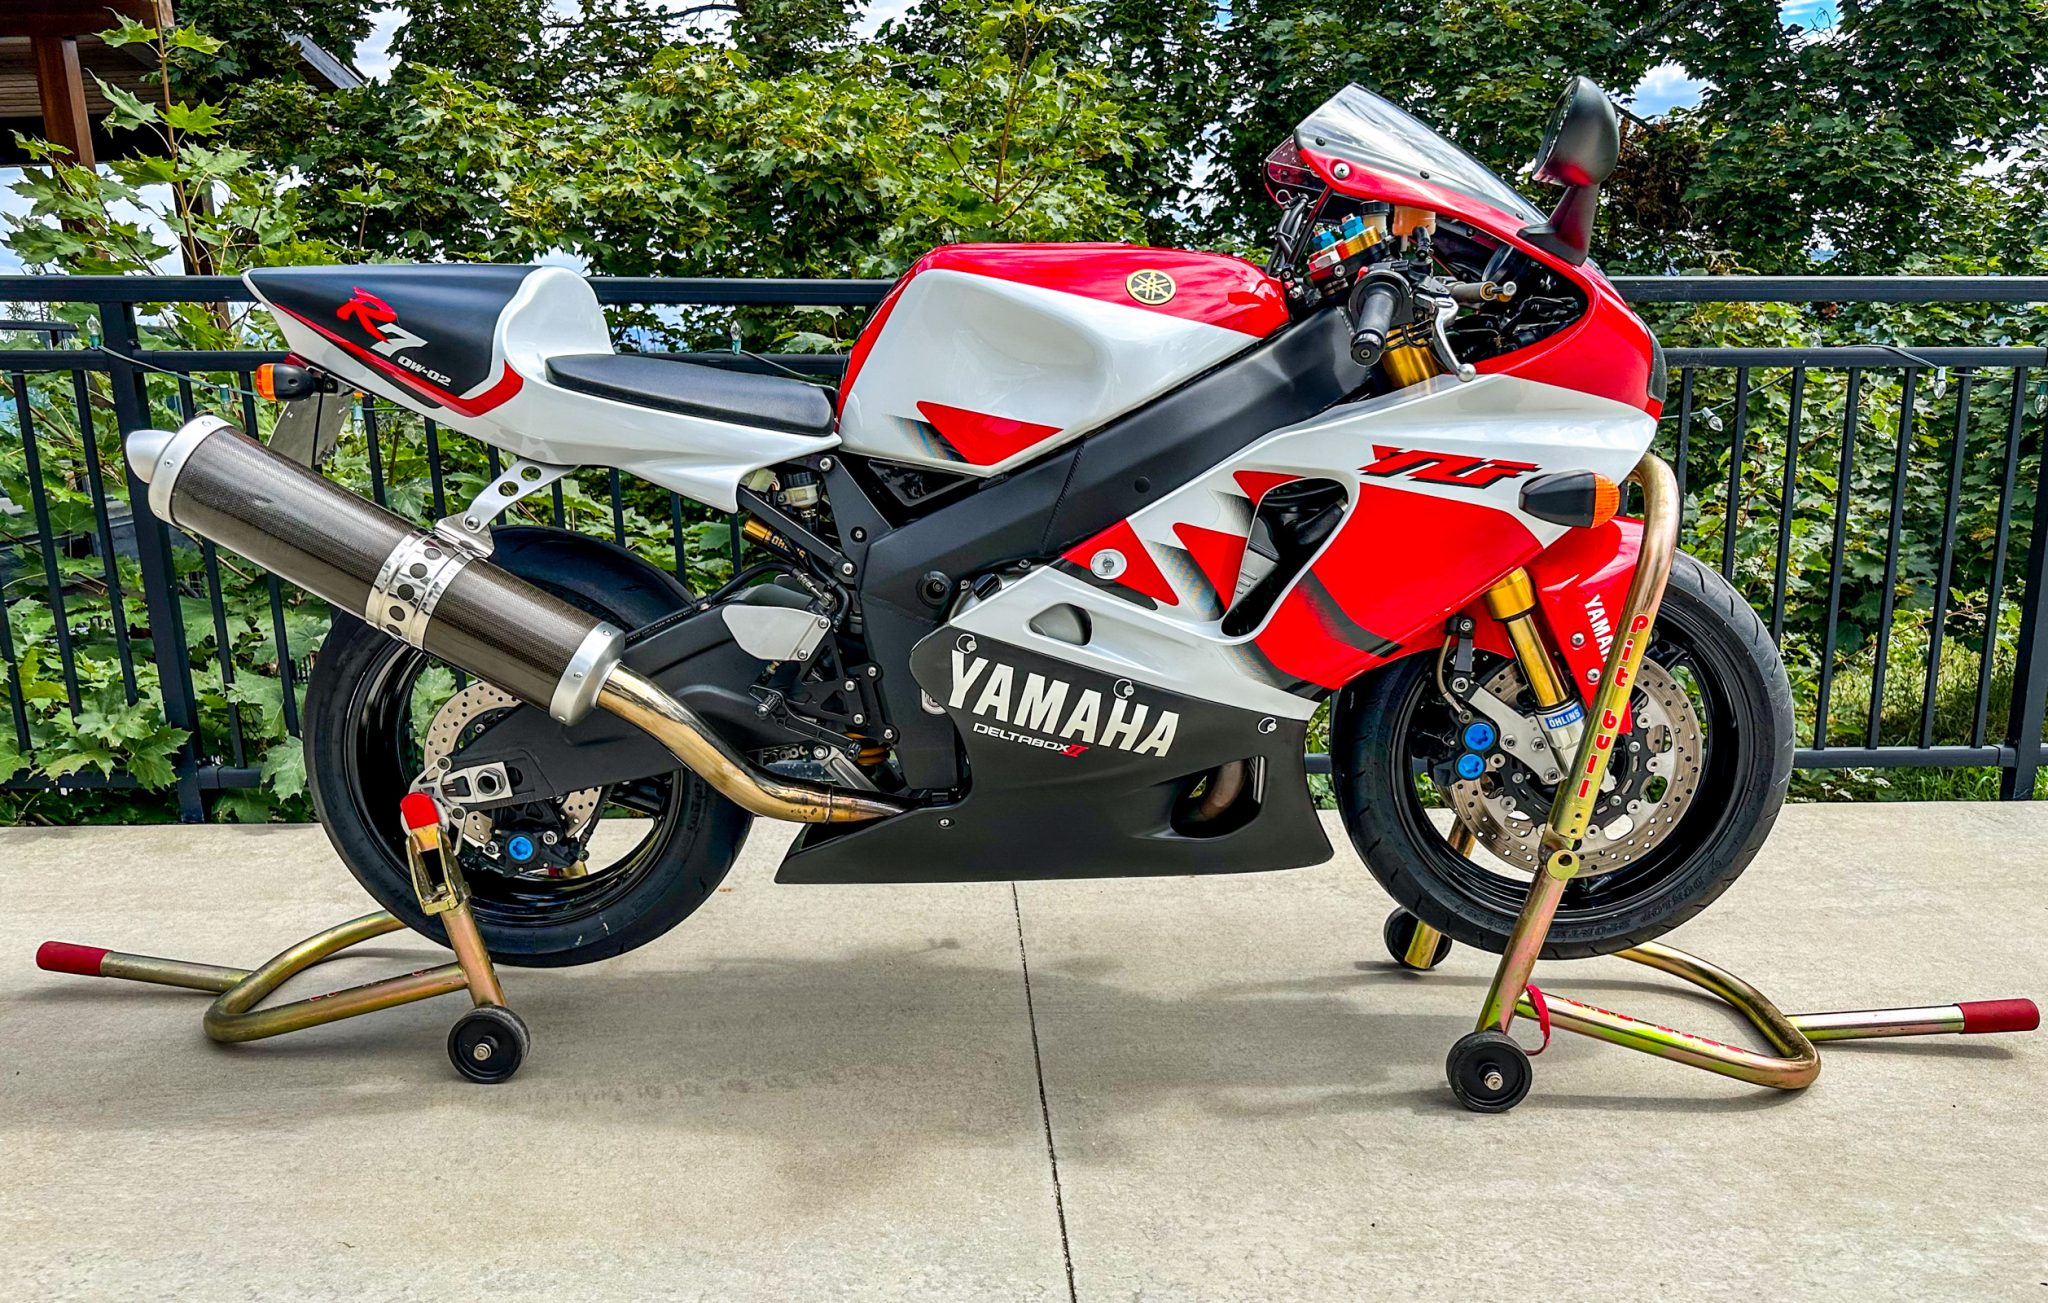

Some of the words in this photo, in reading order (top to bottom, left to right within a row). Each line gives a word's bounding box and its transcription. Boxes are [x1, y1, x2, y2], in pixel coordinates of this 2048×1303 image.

[336, 287, 429, 357] R7
[397, 354, 452, 387] OW-02
[1356, 444, 1542, 489] YZF
[948, 649, 1180, 758] YAMAHA
